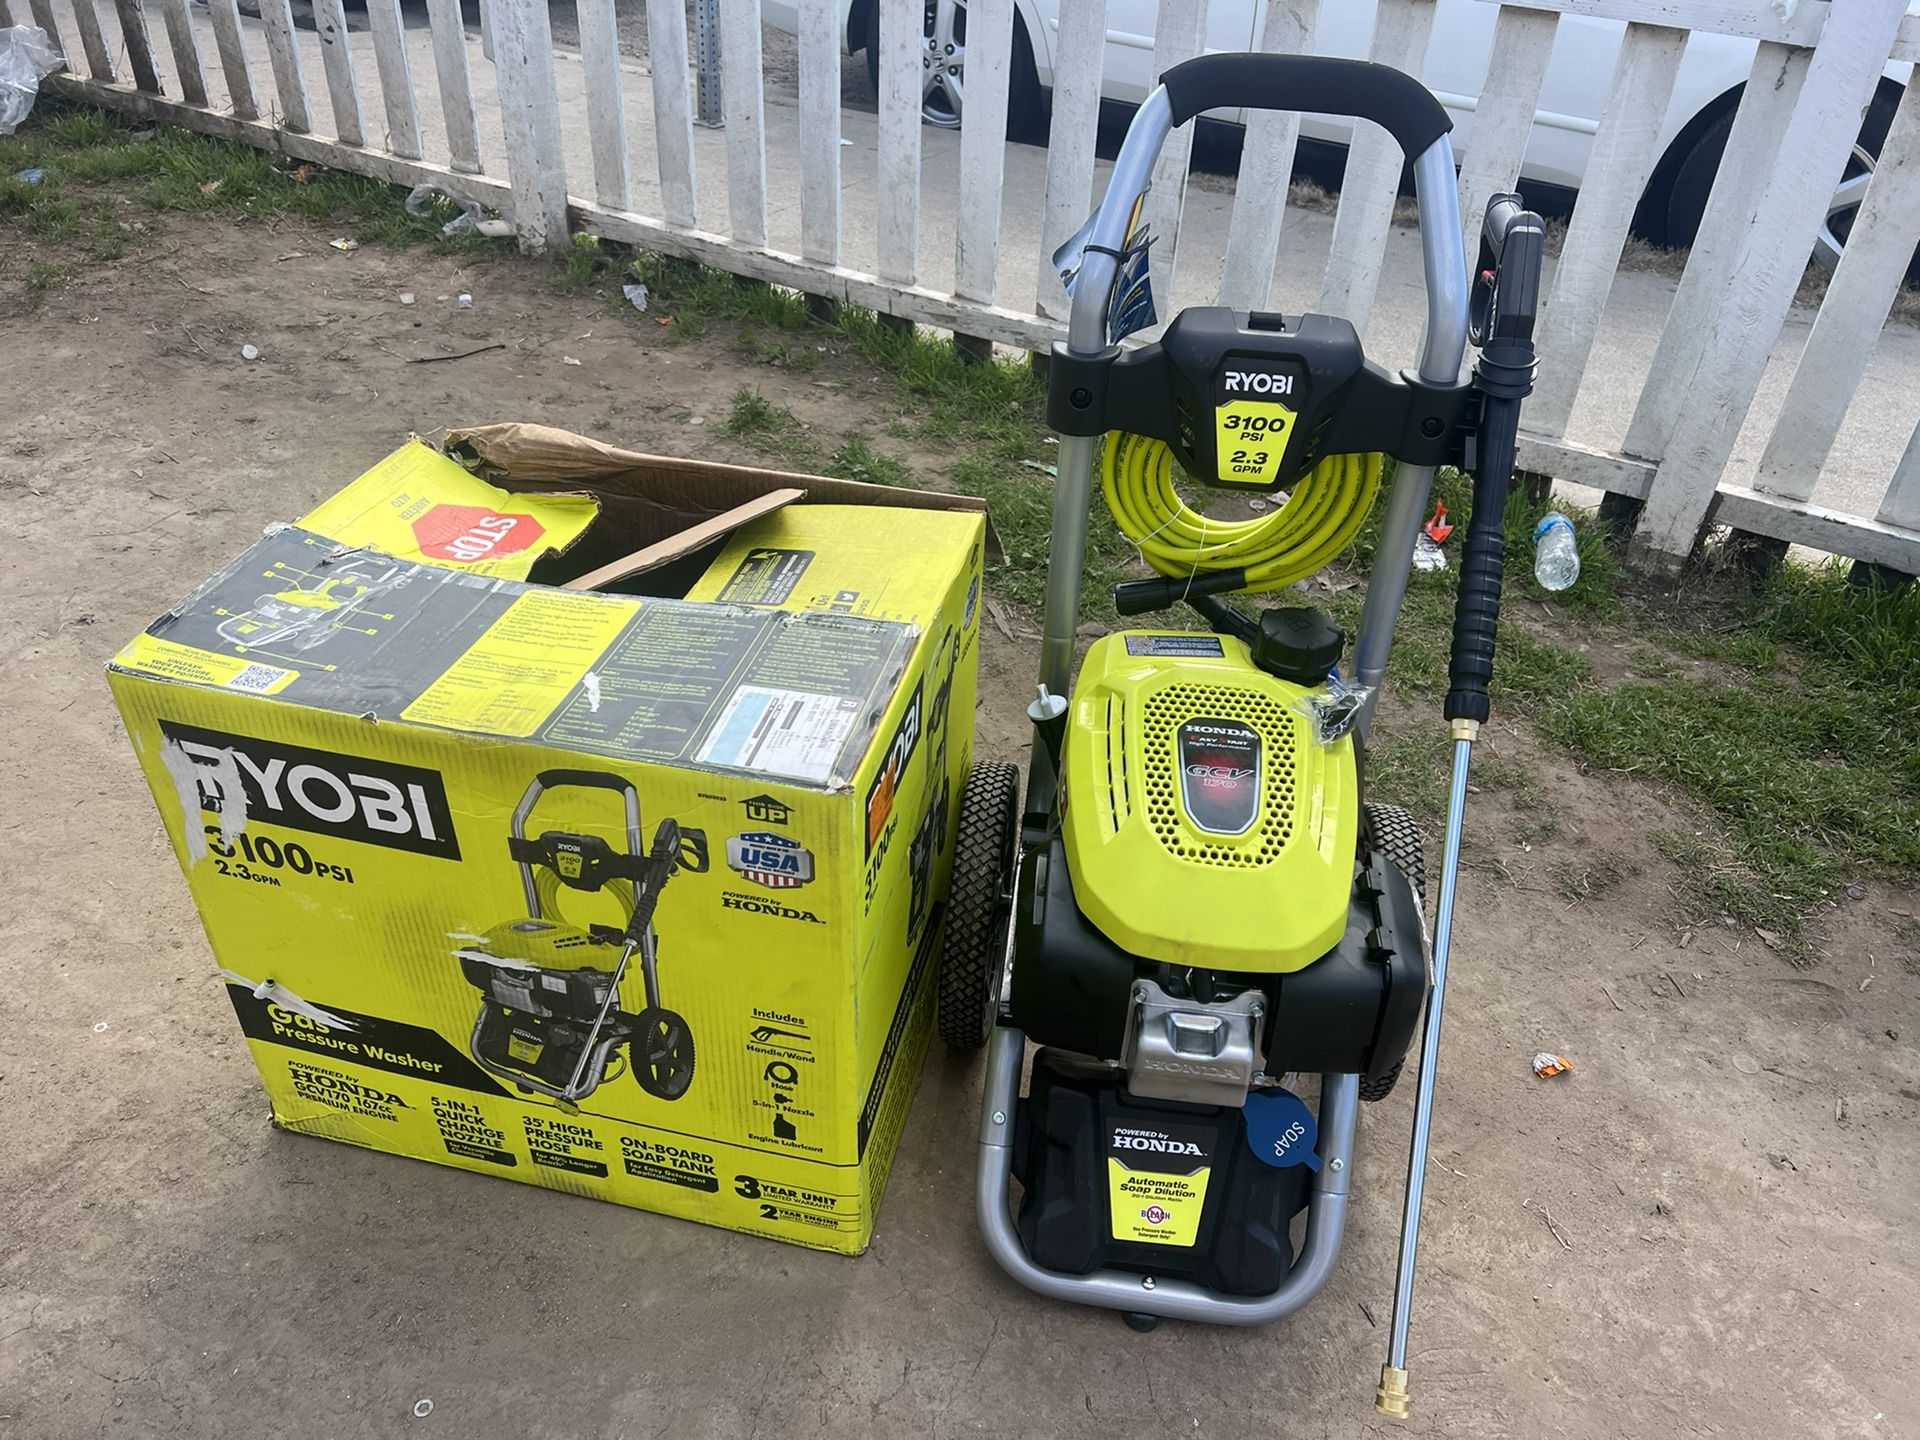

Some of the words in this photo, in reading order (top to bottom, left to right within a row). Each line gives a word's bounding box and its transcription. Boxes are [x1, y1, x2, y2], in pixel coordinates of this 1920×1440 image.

[1224, 370, 1294, 395] RYOBI
[1223, 414, 1286, 433] 3100
[1239, 432, 1264, 442] PSI
[1230, 450, 1269, 465] 2.3
[1232, 464, 1263, 475] GPM
[444, 516, 518, 560] STOP
[1186, 725, 1256, 738] HONDA
[1186, 764, 1255, 780] GCV
[1203, 778, 1237, 788] 170
[749, 806, 786, 821] UP
[741, 847, 799, 873] USA
[722, 890, 769, 903] POWERED
[721, 897, 821, 924] HONDA
[753, 1008, 805, 1025] Includes
[272, 1022, 360, 1055] Pressure
[363, 1043, 443, 1074] Washer
[746, 1044, 816, 1064] Handle/Wand
[287, 1059, 344, 1080] POWERED
[346, 1076, 360, 1085] by
[1144, 1059, 1241, 1080] HONDA
[288, 1067, 411, 1109] HONDA
[771, 1082, 794, 1092] Hose
[292, 1081, 350, 1103] GCV170
[354, 1096, 393, 1115] 167cc
[296, 1090, 351, 1113] PREMIUM
[351, 1106, 399, 1123] ENGINE
[430, 1096, 480, 1115] 5-IN-1
[752, 1099, 780, 1111] 5-in-1
[783, 1105, 815, 1117] Nozzle
[433, 1108, 487, 1127] QUICK
[522, 1115, 544, 1127] 35'
[548, 1120, 593, 1138] HIGH
[436, 1119, 505, 1141] CHANGE
[439, 1128, 504, 1150] NOZZLE
[524, 1126, 604, 1151] PRESSURE
[1115, 1127, 1157, 1138] POWERED
[1274, 1121, 1305, 1157] SOAP
[526, 1137, 571, 1154] HOSE
[620, 1136, 714, 1164] ON-BOARD
[748, 1132, 780, 1146] Engine
[781, 1139, 824, 1154] Lubricant
[1112, 1135, 1204, 1157] HONDA
[621, 1147, 666, 1164] SOAP
[669, 1157, 717, 1176] TANK
[734, 1174, 762, 1199] 3
[760, 1183, 797, 1197] YEAR
[801, 1192, 838, 1206] UNIT
[1119, 1183, 1152, 1194] Soap
[1154, 1187, 1196, 1198] Dilution
[1127, 1176, 1189, 1190] Automatic
[763, 1191, 793, 1203] LIMITED
[794, 1198, 835, 1211] WARRANTY
[759, 1203, 779, 1221] 2
[778, 1208, 802, 1218] YEAR
[804, 1213, 839, 1227] ENGINE
